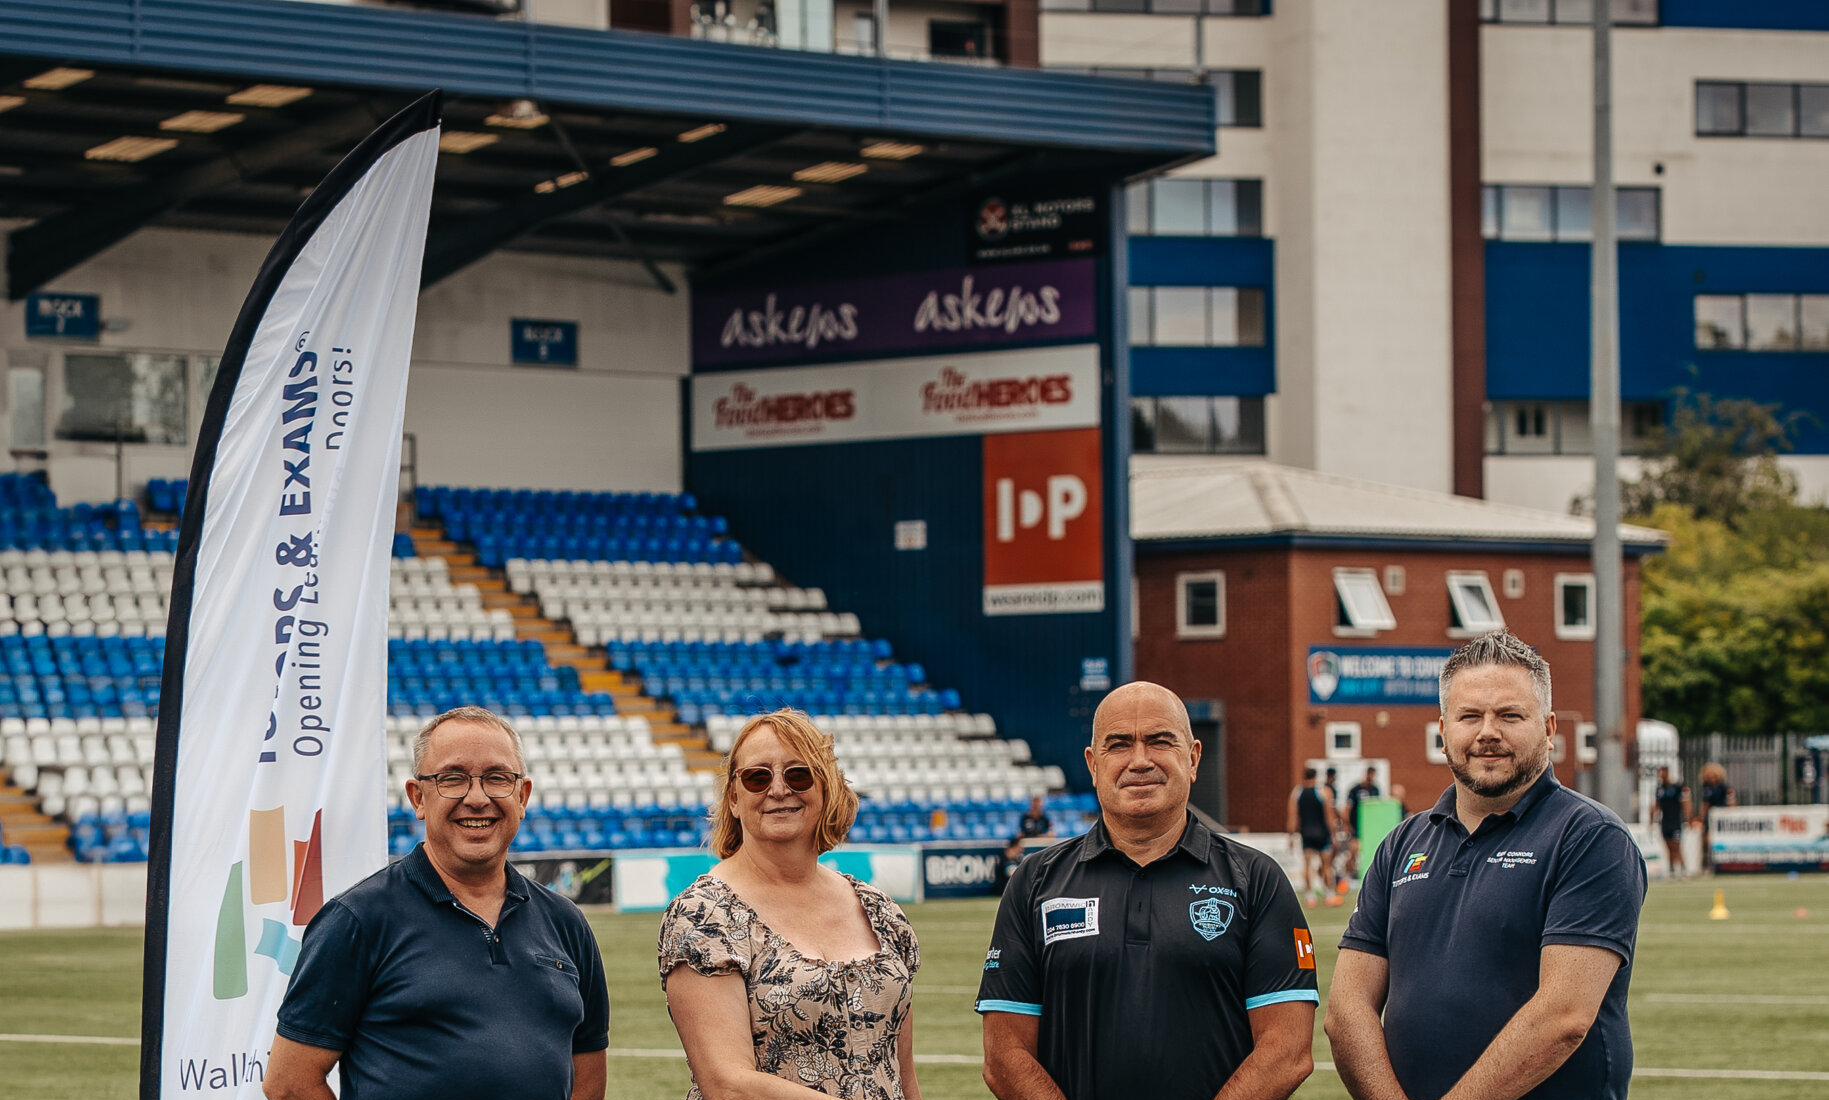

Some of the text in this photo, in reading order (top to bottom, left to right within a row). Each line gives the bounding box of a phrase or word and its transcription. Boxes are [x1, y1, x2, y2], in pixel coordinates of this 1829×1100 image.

[276, 531, 312, 568] &
[1341, 655, 1395, 678] WELCOME
[291, 619, 331, 757] Opening
[926, 855, 1000, 885] BROM
[1208, 886, 1237, 898] OXEN
